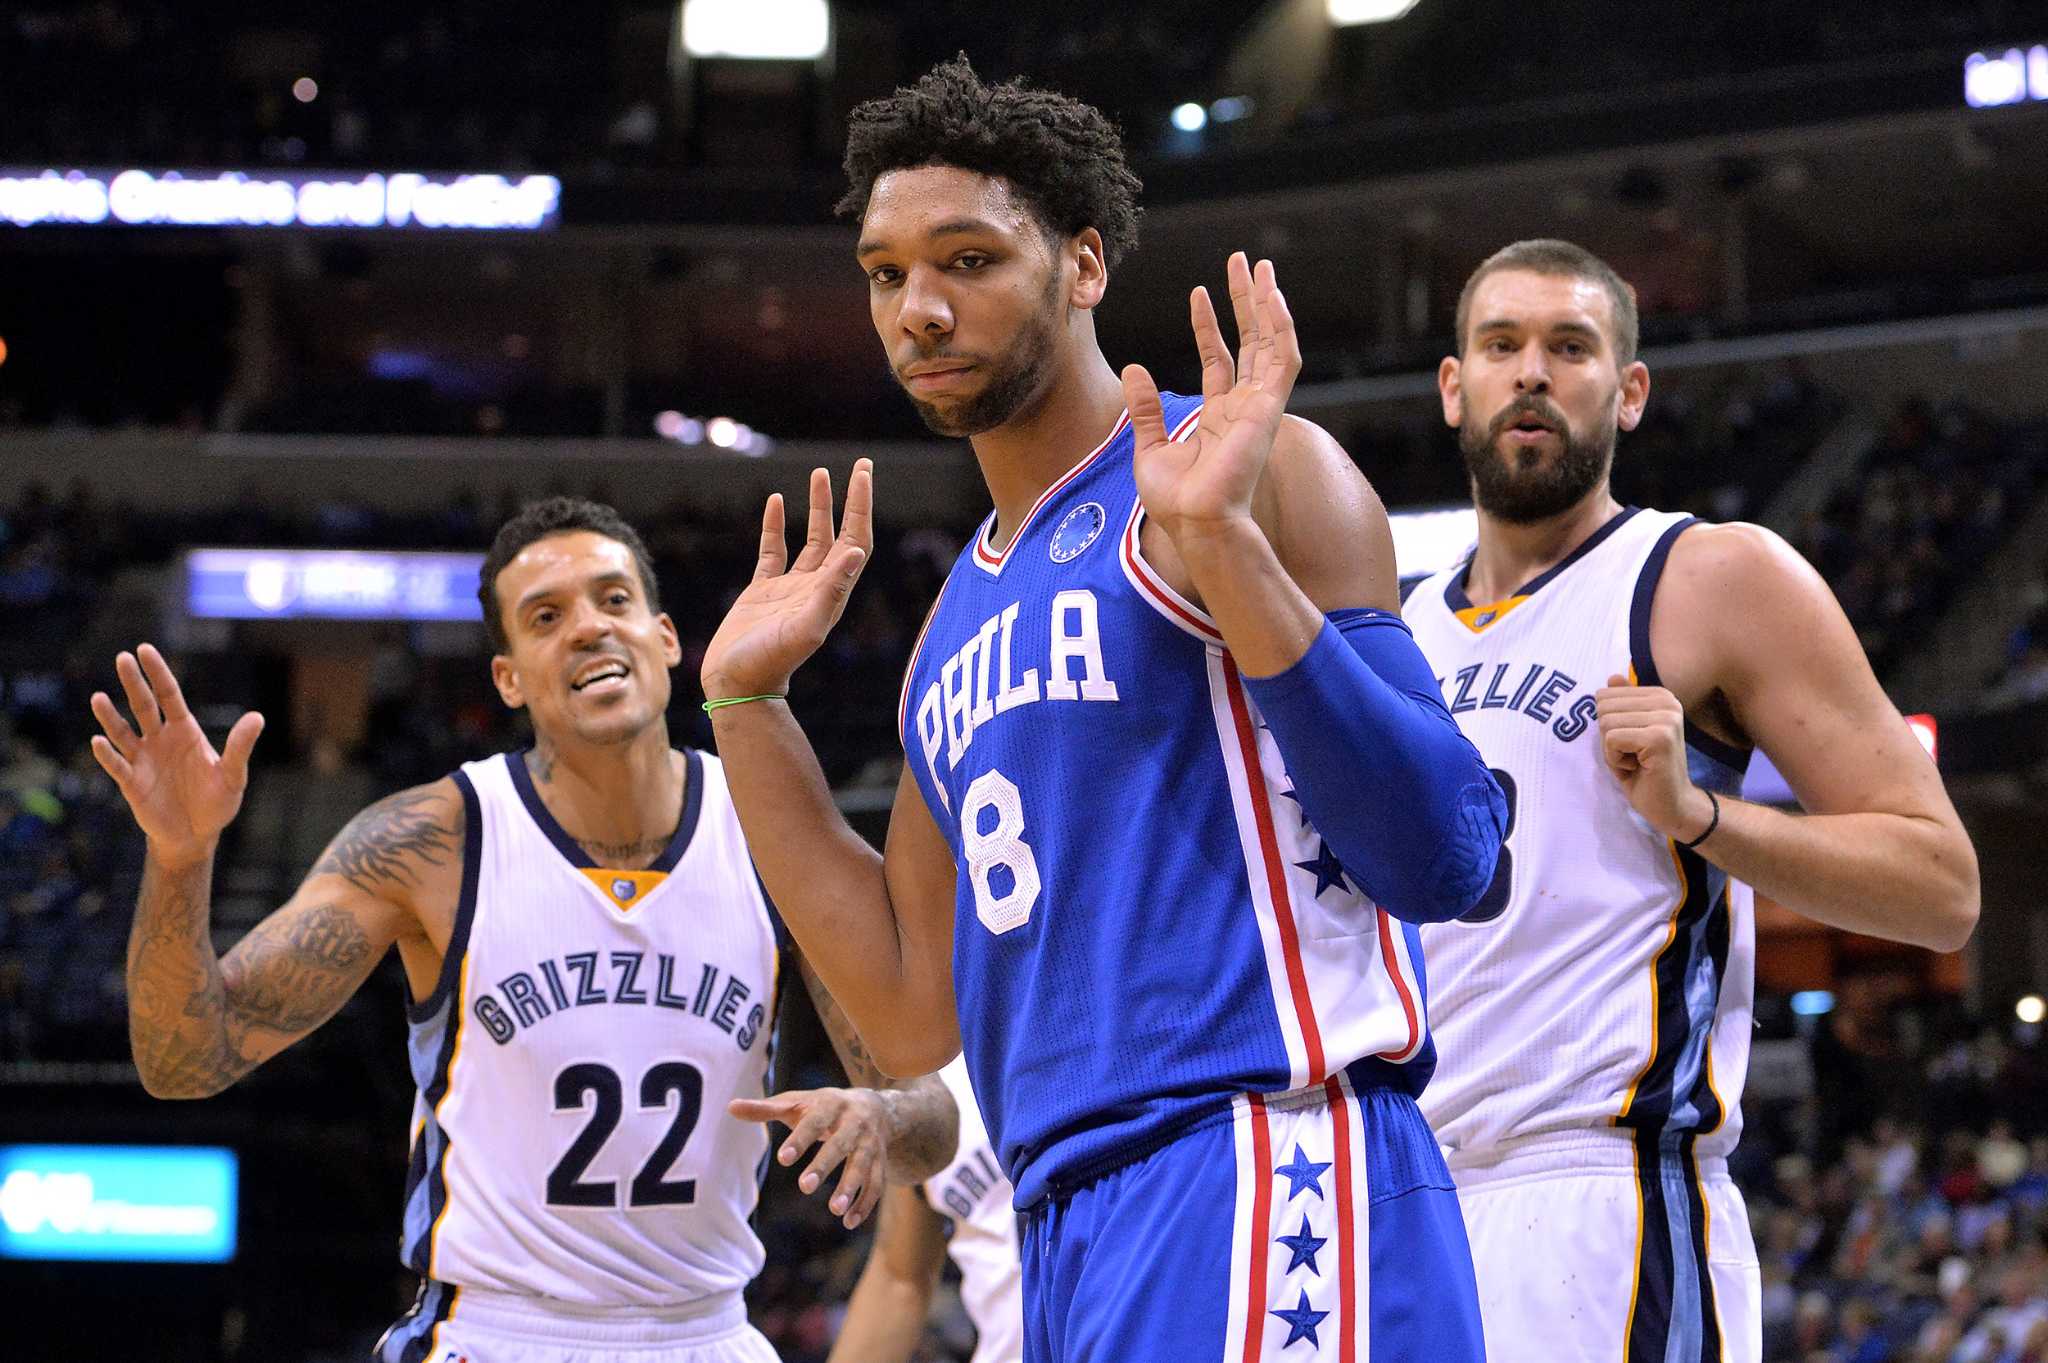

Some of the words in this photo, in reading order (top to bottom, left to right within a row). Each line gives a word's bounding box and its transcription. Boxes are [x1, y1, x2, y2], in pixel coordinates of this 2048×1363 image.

[916, 589, 1120, 816] PHILA
[1437, 662, 1598, 742] ZLIES
[961, 768, 1042, 935] 8
[473, 951, 765, 1051] GRIZZLIES
[546, 1061, 704, 1208] 22
